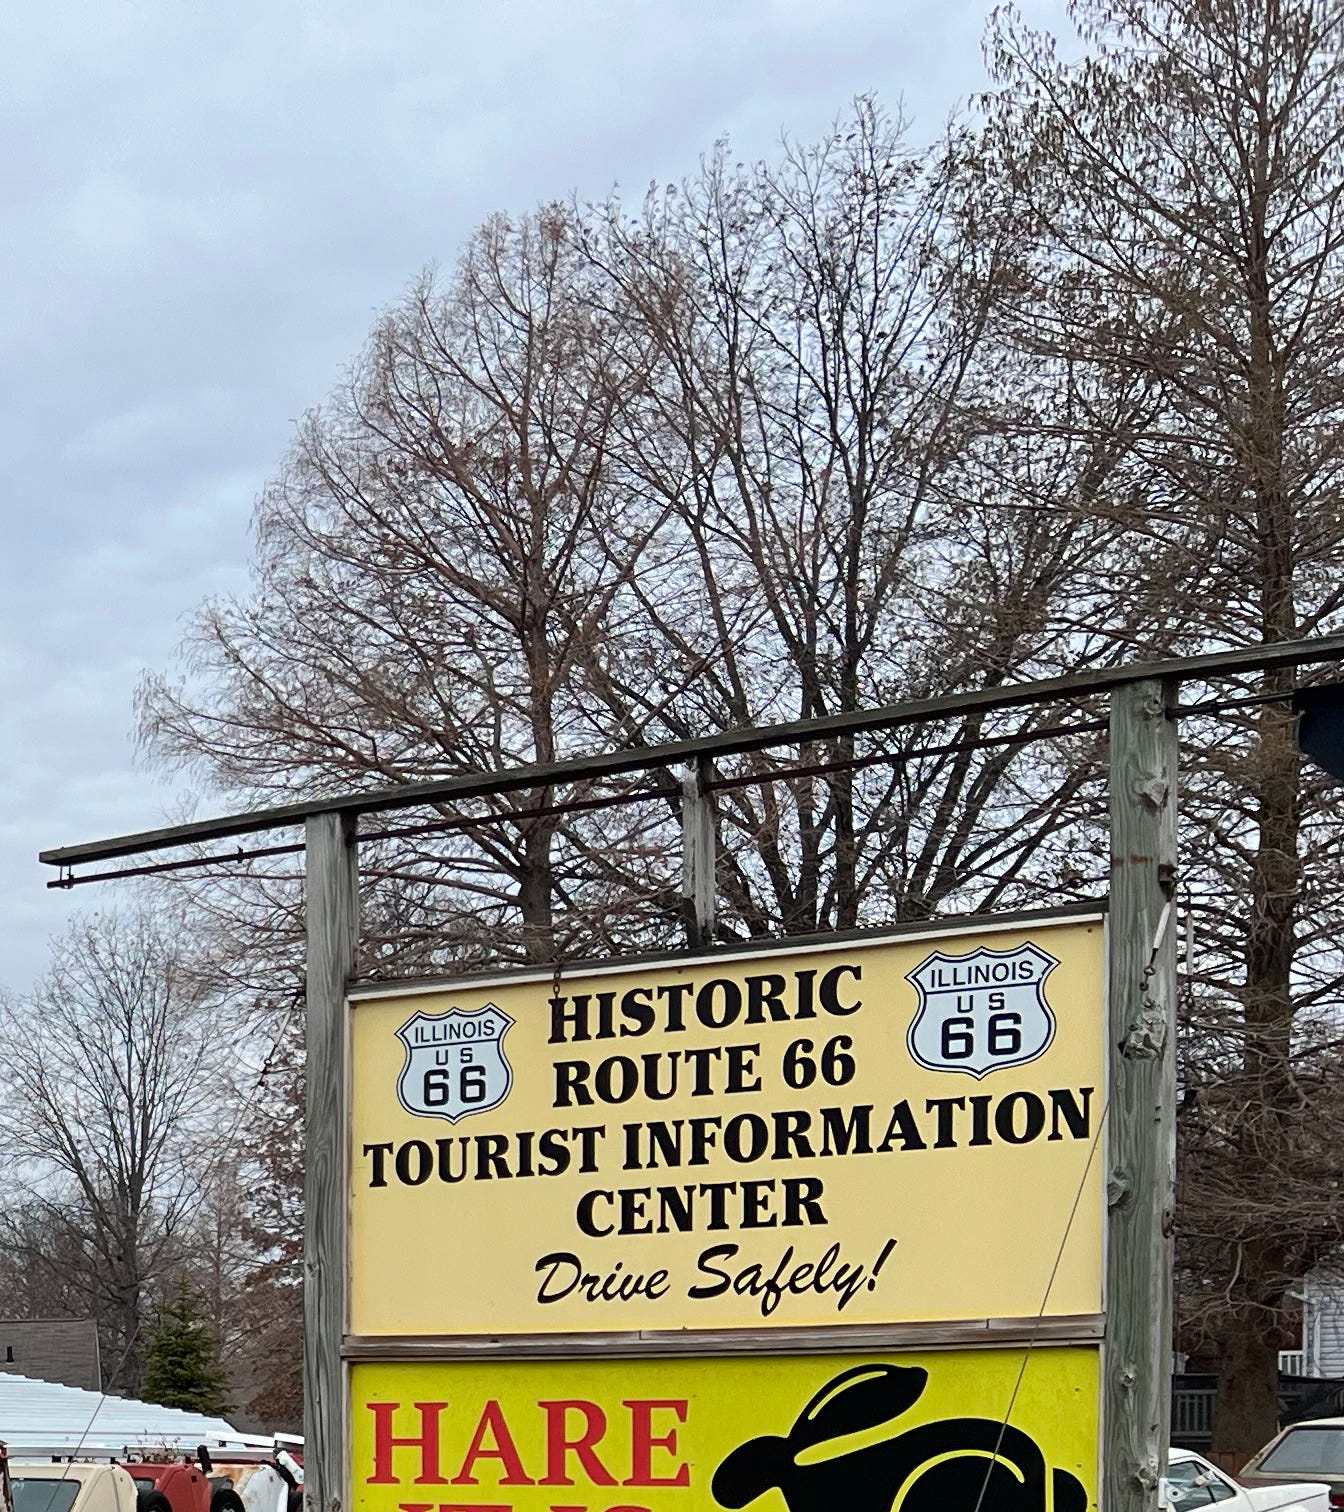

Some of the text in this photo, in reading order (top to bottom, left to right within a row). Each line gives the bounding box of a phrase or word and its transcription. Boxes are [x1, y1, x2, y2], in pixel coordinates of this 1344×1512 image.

[547, 965, 863, 1044] HISTORIC
[930, 960, 1034, 988] ILLINOIS
[414, 1019, 496, 1044] ILLINOIS
[940, 1012, 1022, 1060] 66
[423, 1065, 487, 1108] 66
[552, 1034, 856, 1108] ROUTE 66
[362, 1086, 1095, 1188] TOURIST INFORMATION
[576, 1176, 829, 1237] CENTER
[534, 1238, 898, 1317] Drive Safely!
[365, 1399, 691, 1488] HARE
